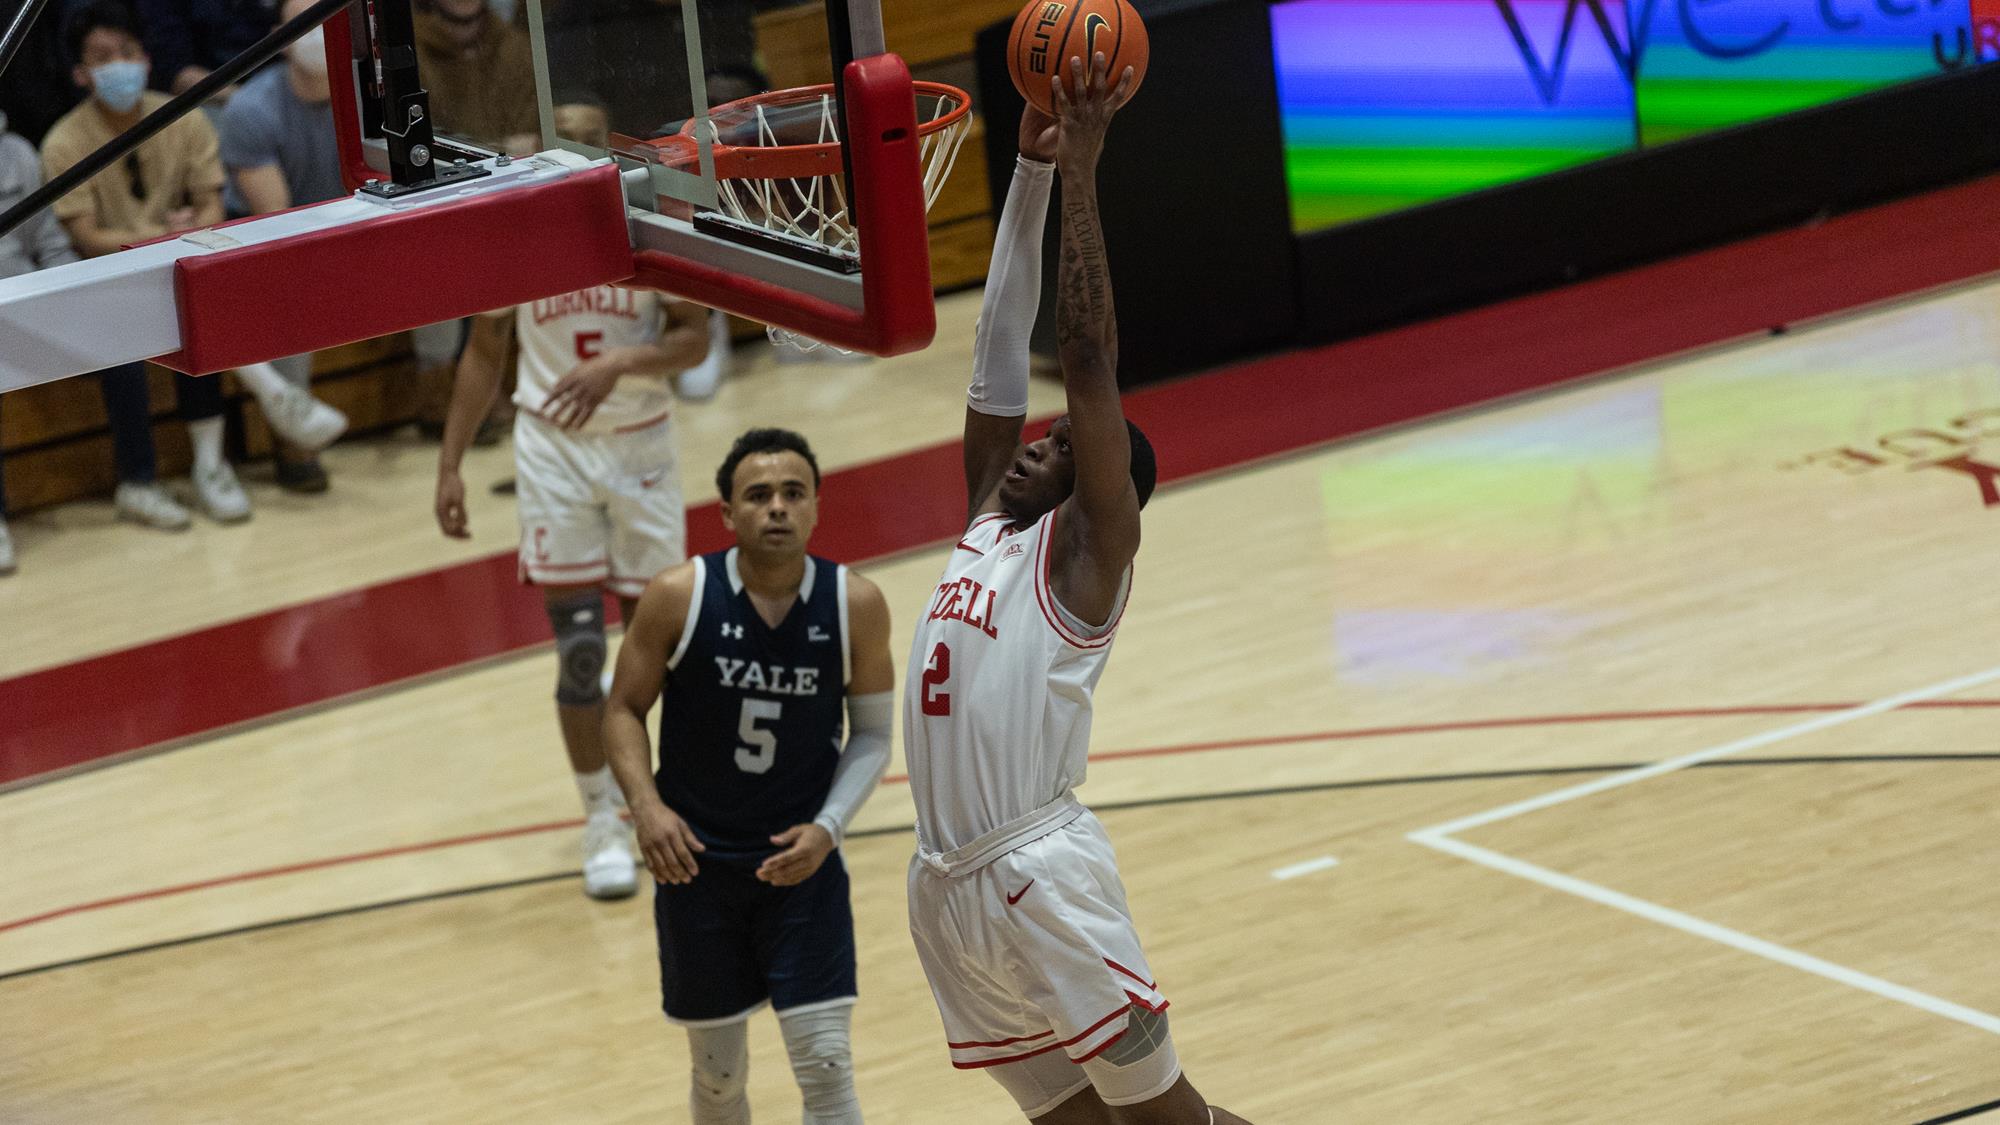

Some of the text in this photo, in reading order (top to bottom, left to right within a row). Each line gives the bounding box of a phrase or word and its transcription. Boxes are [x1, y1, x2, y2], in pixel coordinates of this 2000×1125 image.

[1029, 1, 1068, 75] ELITE
[714, 655, 821, 697] YALE
[921, 641, 951, 717] 2
[733, 697, 783, 776] 5
